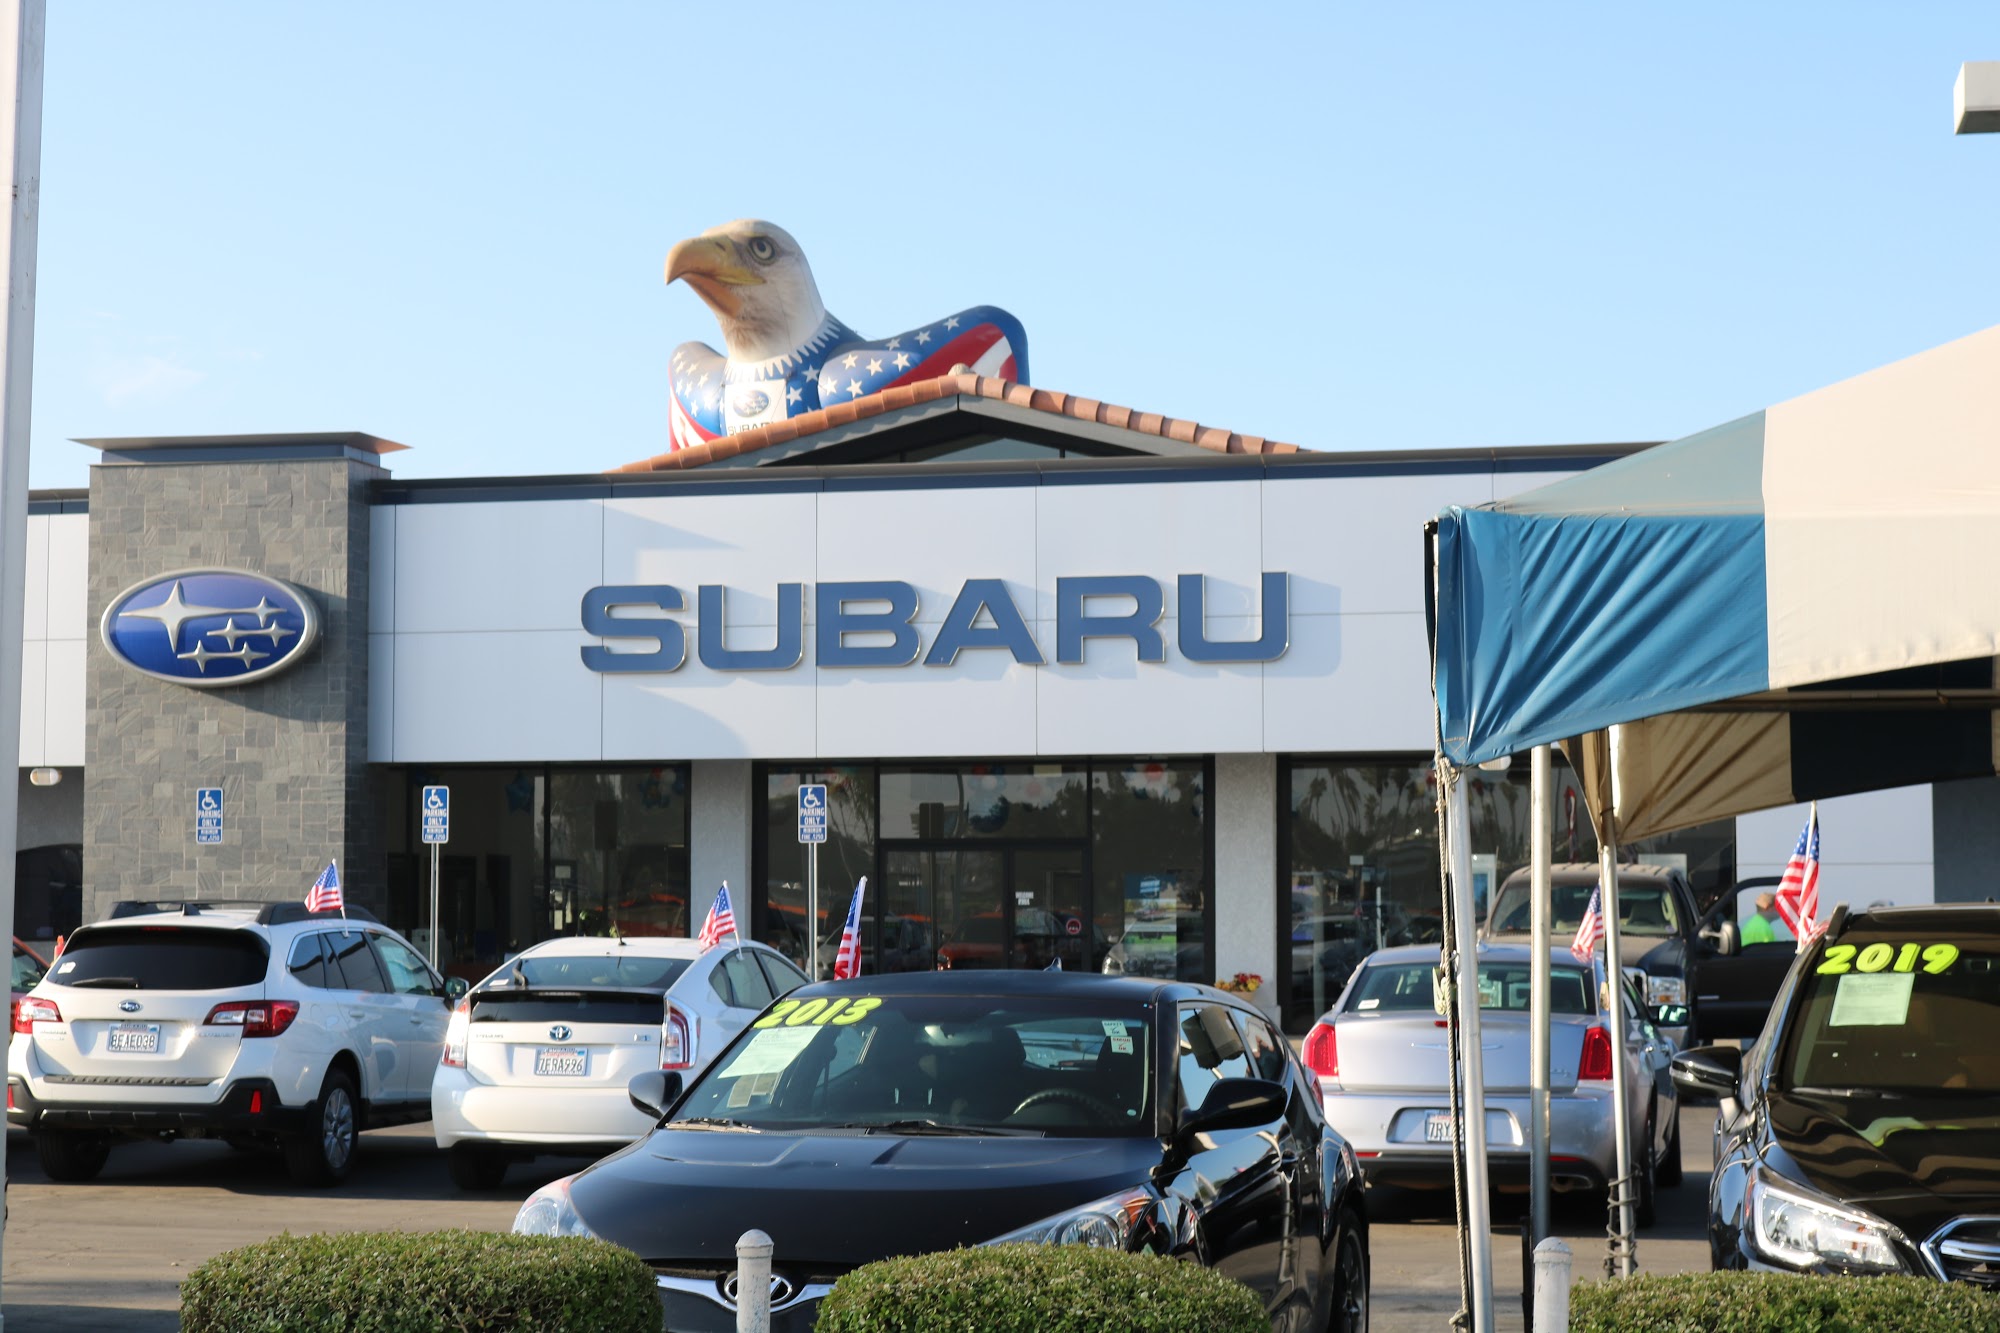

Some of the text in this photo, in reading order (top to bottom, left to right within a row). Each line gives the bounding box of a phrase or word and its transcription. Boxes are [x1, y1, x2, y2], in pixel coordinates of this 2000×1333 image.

[580, 571, 1289, 673] SUBARU
[198, 809, 221, 818] PARKING
[424, 808, 447, 817] PARKING
[800, 807, 825, 816] PARKING
[202, 818, 217, 827] ONLY
[428, 817, 443, 826] ONLY
[804, 816, 820, 825] ONLY
[1817, 943, 1960, 974] 2019
[753, 998, 882, 1028] 2013
